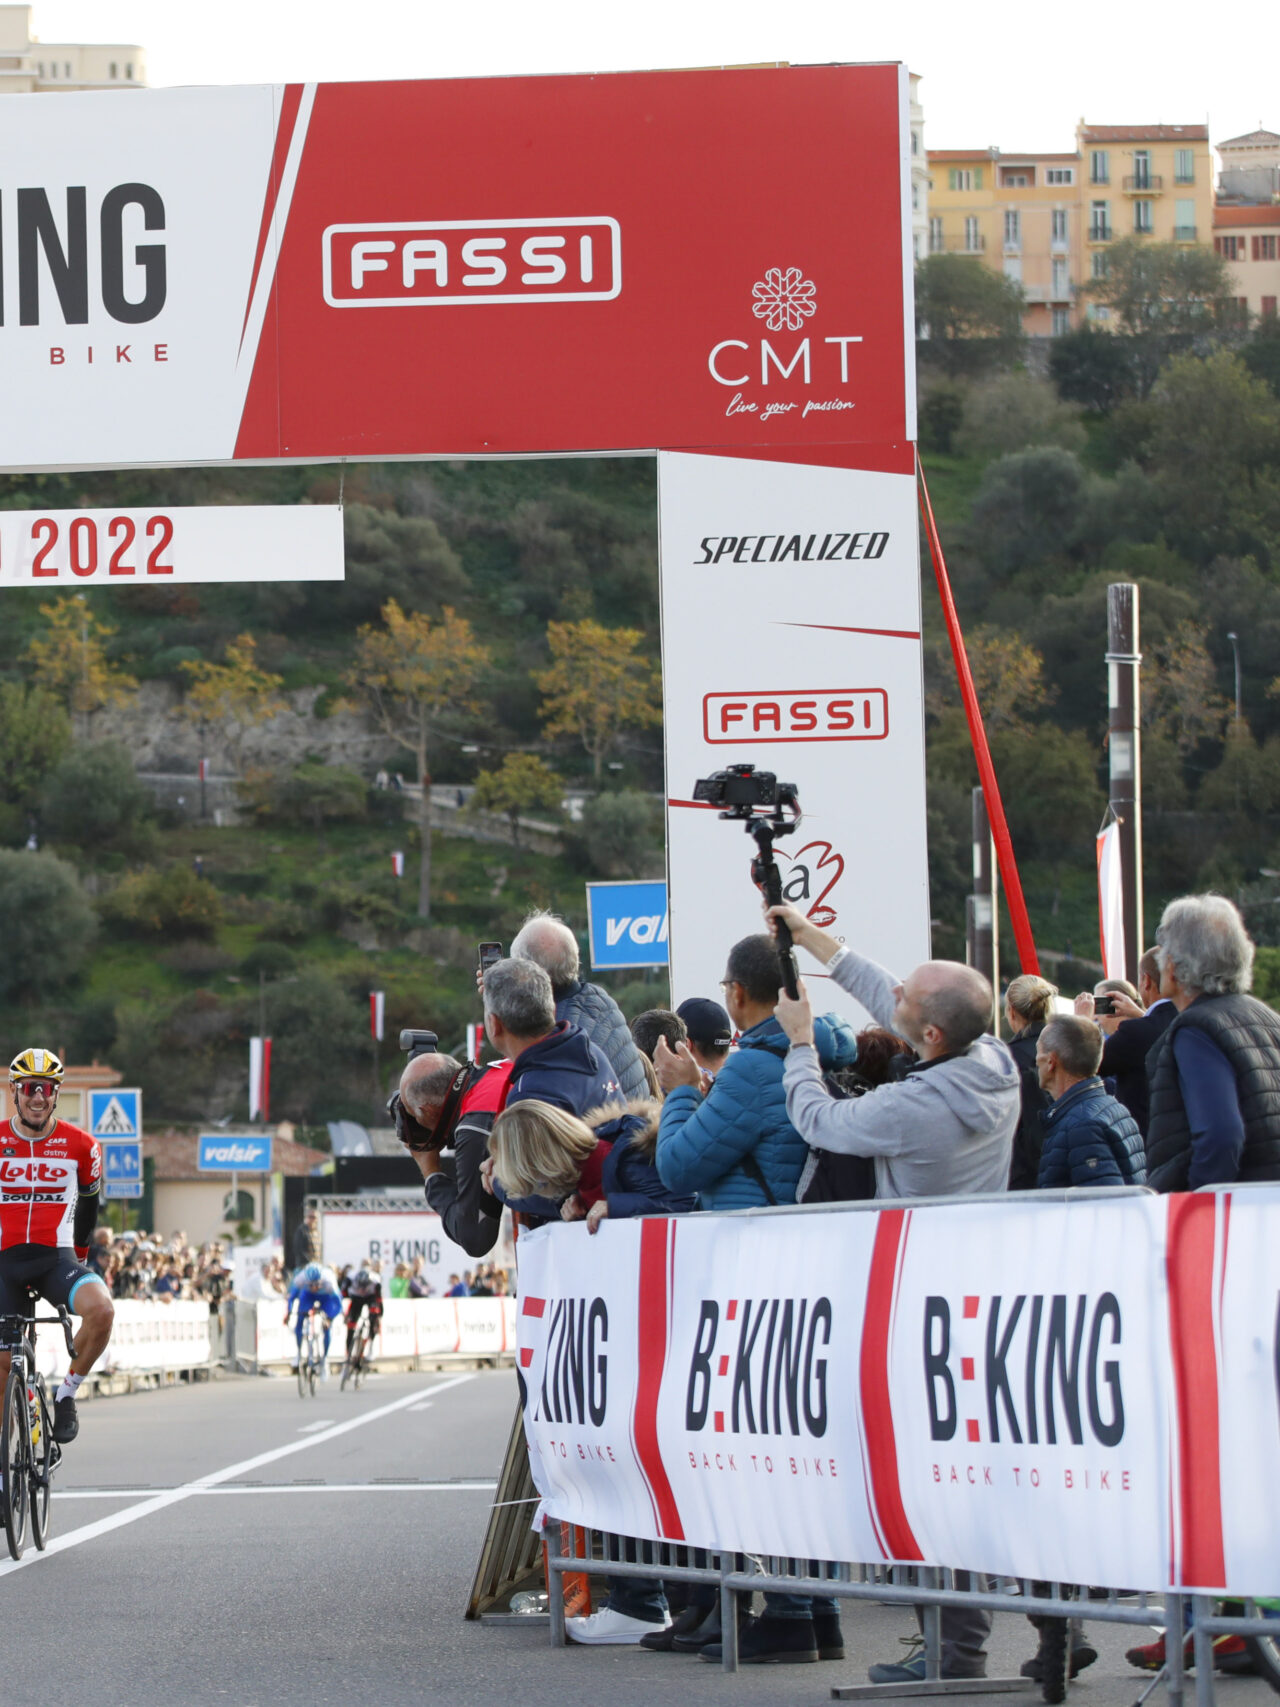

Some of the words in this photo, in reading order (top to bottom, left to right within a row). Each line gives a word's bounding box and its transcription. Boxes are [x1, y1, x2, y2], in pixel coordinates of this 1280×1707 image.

[351, 235, 592, 289] FASSI
[50, 343, 168, 365] BIKE
[708, 336, 863, 386] CMT
[761, 399, 798, 422] your
[801, 397, 855, 417] passion
[31, 515, 174, 577] 2022
[693, 531, 890, 565] SPECIALIZED
[721, 700, 871, 732] FASSI
[204, 1143, 262, 1163] valsir
[2, 1193, 64, 1202] SOUDAL
[551, 1441, 567, 1459] TO
[580, 1444, 617, 1463] BIKE
[690, 1451, 738, 1471] BACK
[752, 1455, 773, 1474] TO
[791, 1457, 838, 1477] BIKE
[932, 1464, 993, 1486] BACK
[1013, 1467, 1040, 1488] TO
[1065, 1469, 1132, 1490] BIKE
